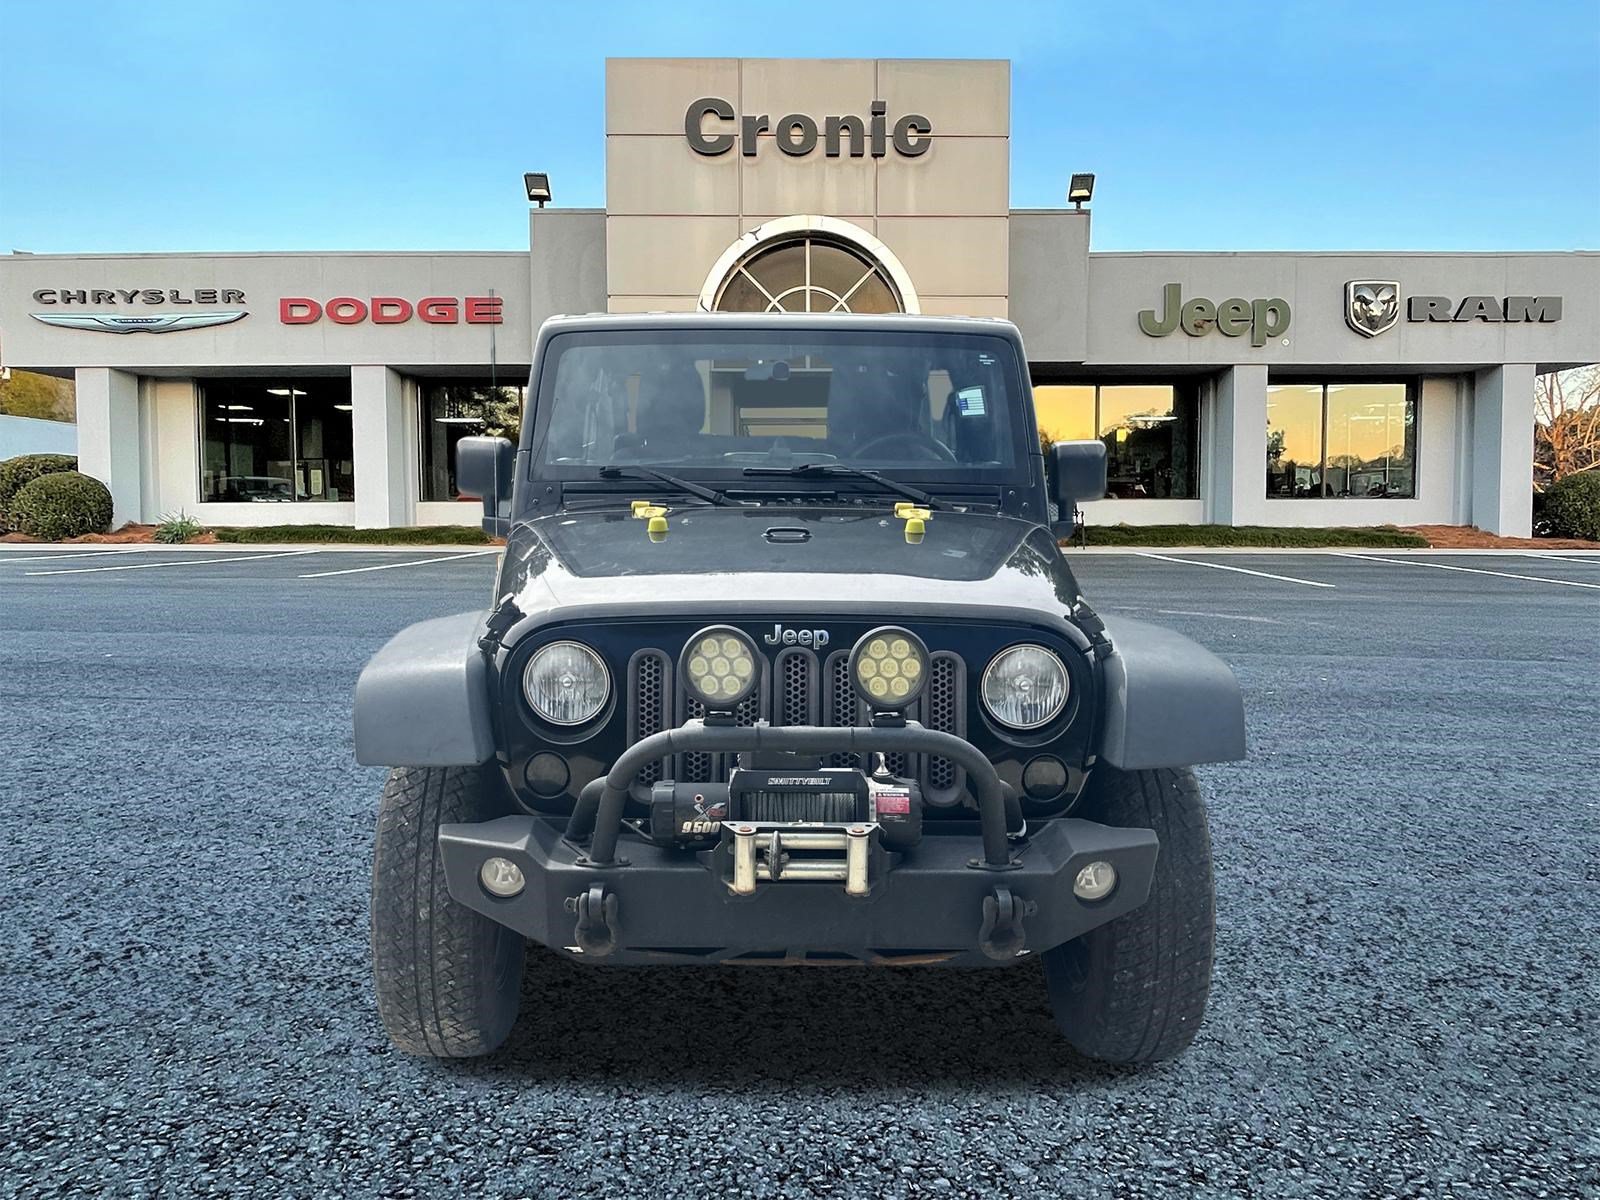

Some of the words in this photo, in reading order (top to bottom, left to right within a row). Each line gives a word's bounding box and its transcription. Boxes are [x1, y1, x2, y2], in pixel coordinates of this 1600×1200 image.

[685, 98, 932, 158] Cronic
[32, 289, 246, 304] CHRYSLER
[1408, 297, 1562, 322] RAM
[280, 297, 503, 325] DODGE
[1139, 284, 1291, 346] Jeep
[764, 624, 829, 650] Jeep
